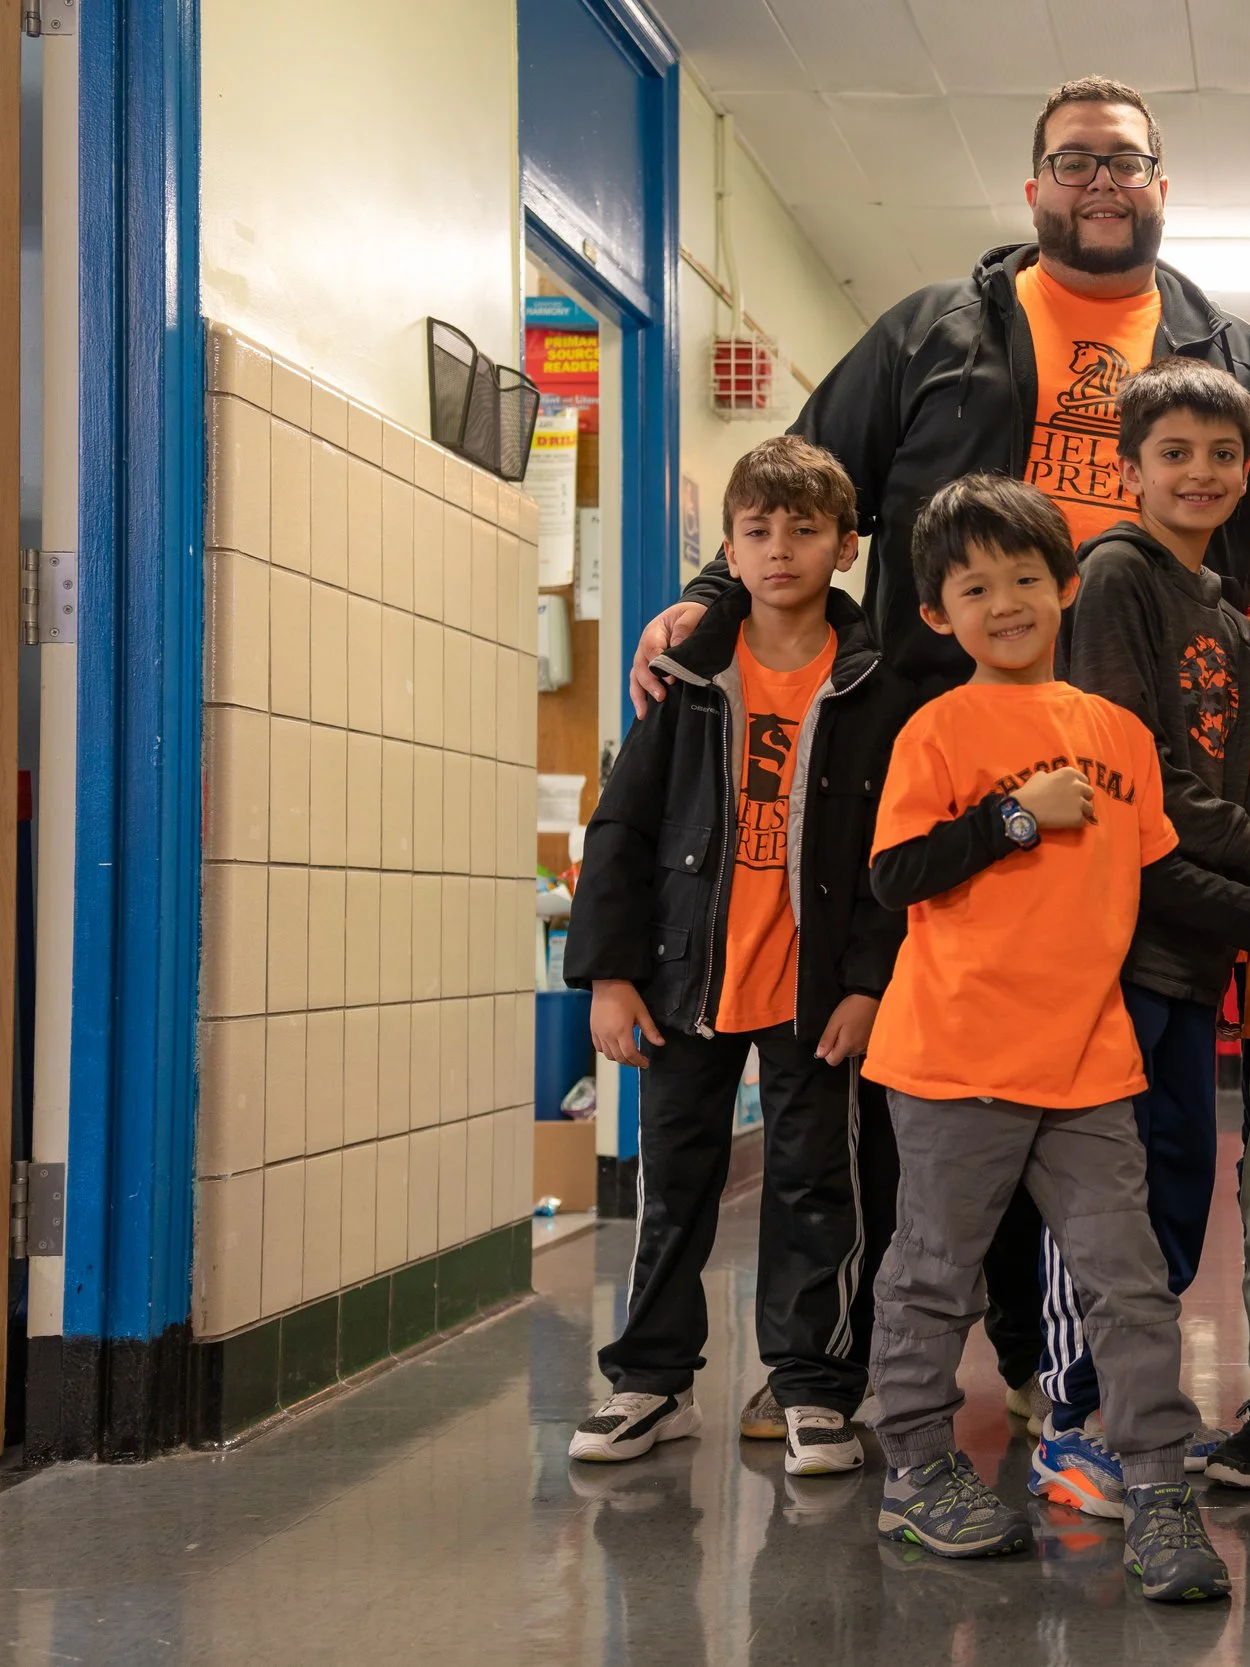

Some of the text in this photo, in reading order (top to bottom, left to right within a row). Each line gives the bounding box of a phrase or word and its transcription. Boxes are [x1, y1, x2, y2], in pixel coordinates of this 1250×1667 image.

[543, 335, 598, 348] PRIMAR
[1032, 431, 1119, 473] HEL
[736, 794, 785, 831] ELS
[736, 825, 787, 862] REP
